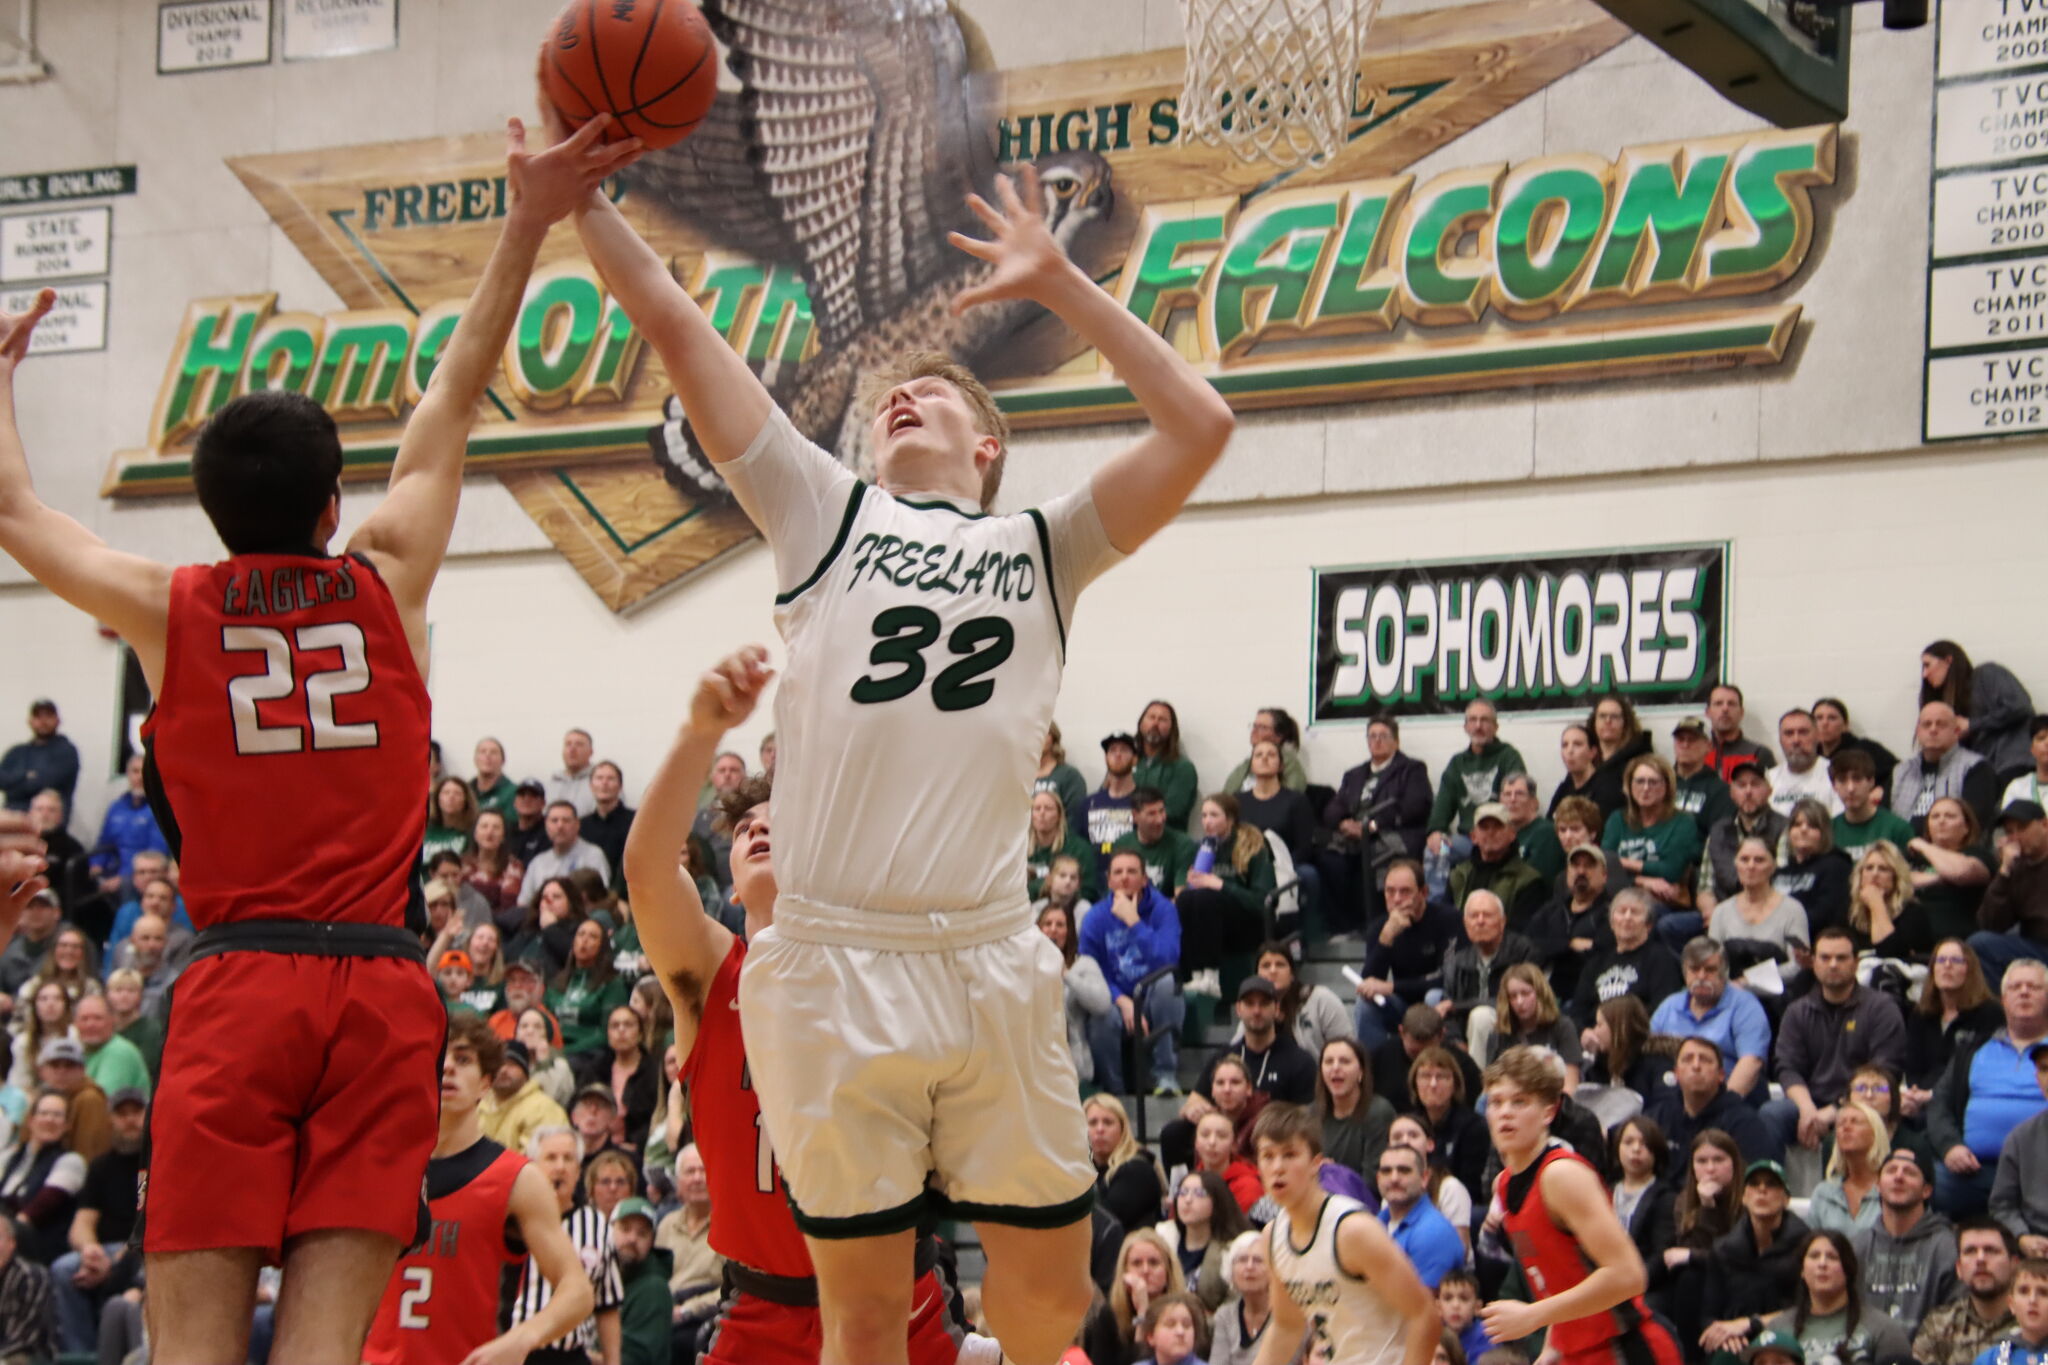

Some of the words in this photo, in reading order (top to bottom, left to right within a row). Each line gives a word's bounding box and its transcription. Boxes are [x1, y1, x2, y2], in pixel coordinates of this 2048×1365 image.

[166, 4, 261, 30] DIVISIONAL
[1982, 16, 2048, 42] CHAM
[188, 28, 242, 44] CHAMPS
[1991, 81, 2048, 110] TVC
[997, 103, 1133, 161] HIGH
[1979, 108, 2048, 134] CHAMP
[0, 177, 40, 200] IRLS
[48, 169, 124, 197] BOWLING
[1990, 172, 2048, 200] TVC
[1976, 200, 2047, 225] CHAMP
[26, 217, 81, 239] STATE
[1991, 221, 2044, 245] 2010
[15, 241, 67, 257] RUNNER
[74, 239, 93, 252] UP
[1118, 132, 1832, 366] FALCONS
[1986, 264, 2048, 291] TVC
[8, 292, 94, 313] RENAL
[1973, 291, 2047, 315] CHAMP
[1987, 313, 2044, 335] 2011
[1983, 356, 2044, 382] TVC
[1984, 405, 2042, 427] 2012
[847, 532, 1035, 602] FREELAND
[222, 562, 357, 617] EAGLES
[1332, 566, 1704, 700] SOPHOMORES
[850, 604, 1015, 712] 32
[221, 621, 381, 757] 22
[399, 1265, 434, 1330] 2
